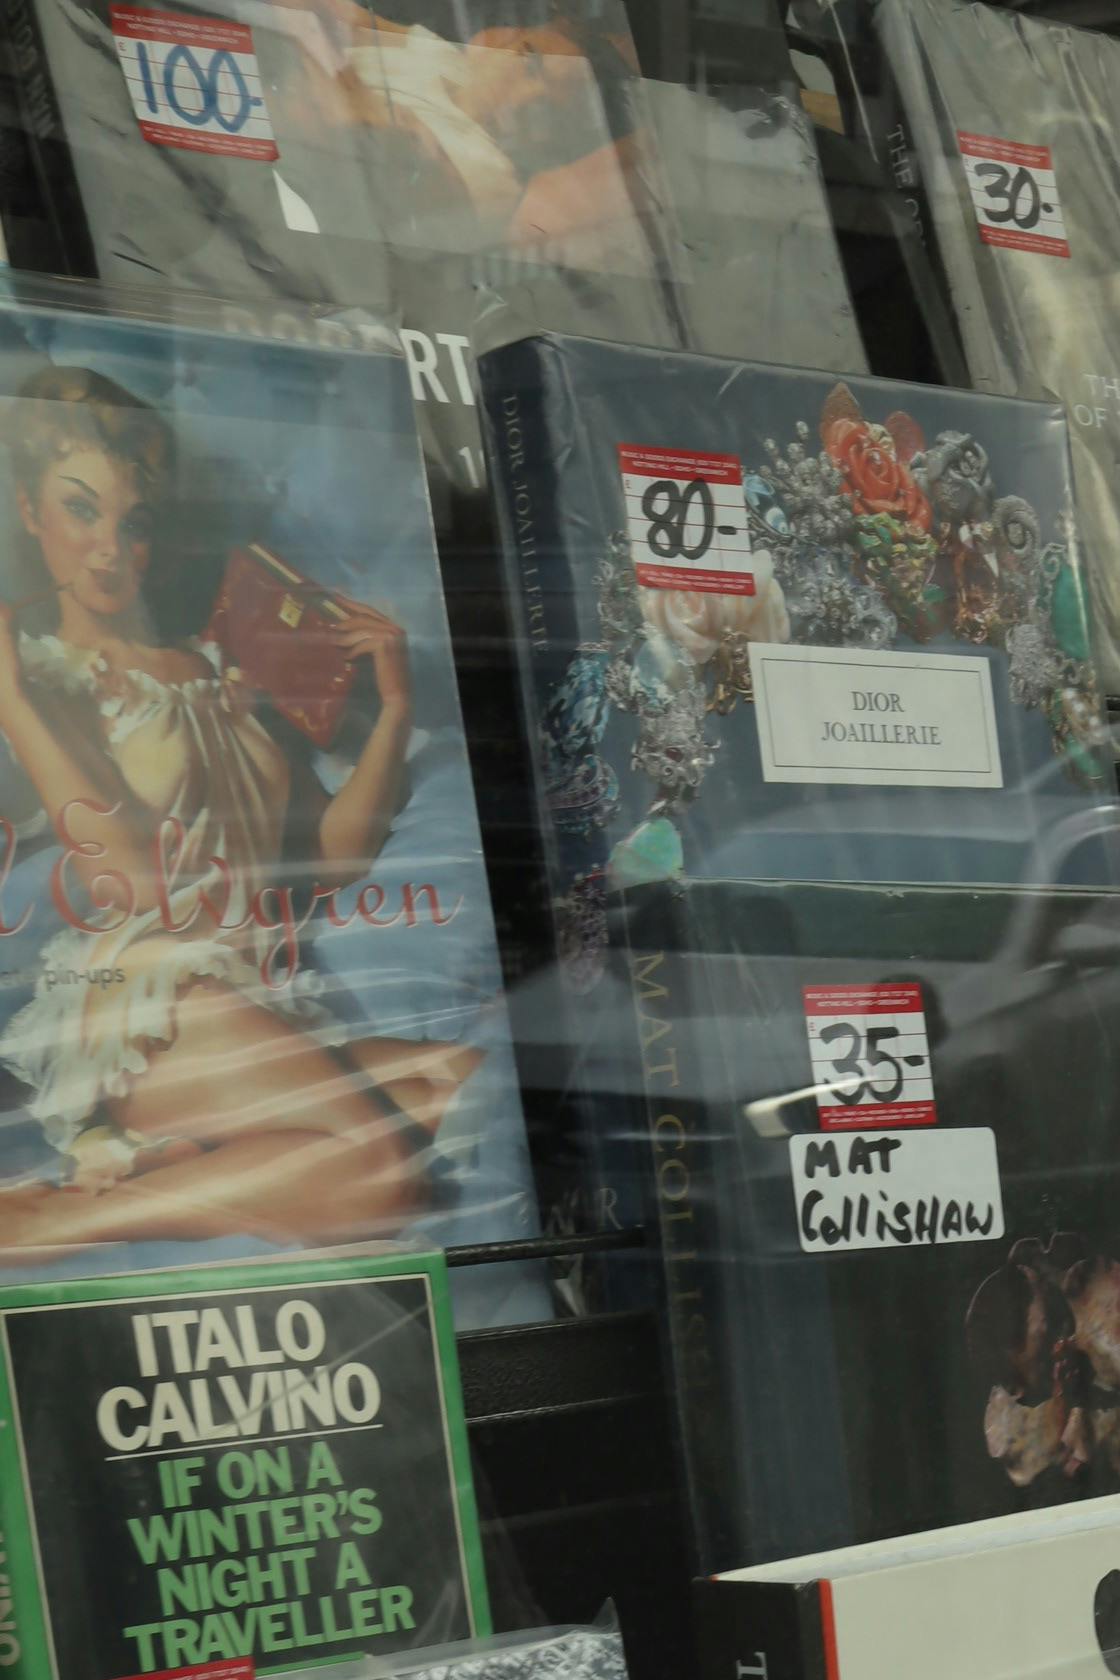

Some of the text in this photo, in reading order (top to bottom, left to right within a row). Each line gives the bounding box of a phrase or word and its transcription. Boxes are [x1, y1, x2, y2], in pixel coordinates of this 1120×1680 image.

[1072, 404, 1108, 428] OF
[821, 721, 942, 745] JOAILLERIE
[851, 691, 905, 712] DIOR
[50, 798, 464, 990] Elvgren
[44, 962, 126, 990] pin-ups
[631, 951, 680, 1088] MAT
[804, 1135, 902, 1179] MAT
[132, 1299, 326, 1377] ITALO
[96, 1362, 382, 1452] CALVINO
[157, 1441, 344, 1509] IF ON A
[127, 1488, 383, 1565] WINTER'S
[157, 1542, 371, 1616] NIGHT A
[123, 1585, 416, 1673] TRAVELLER
